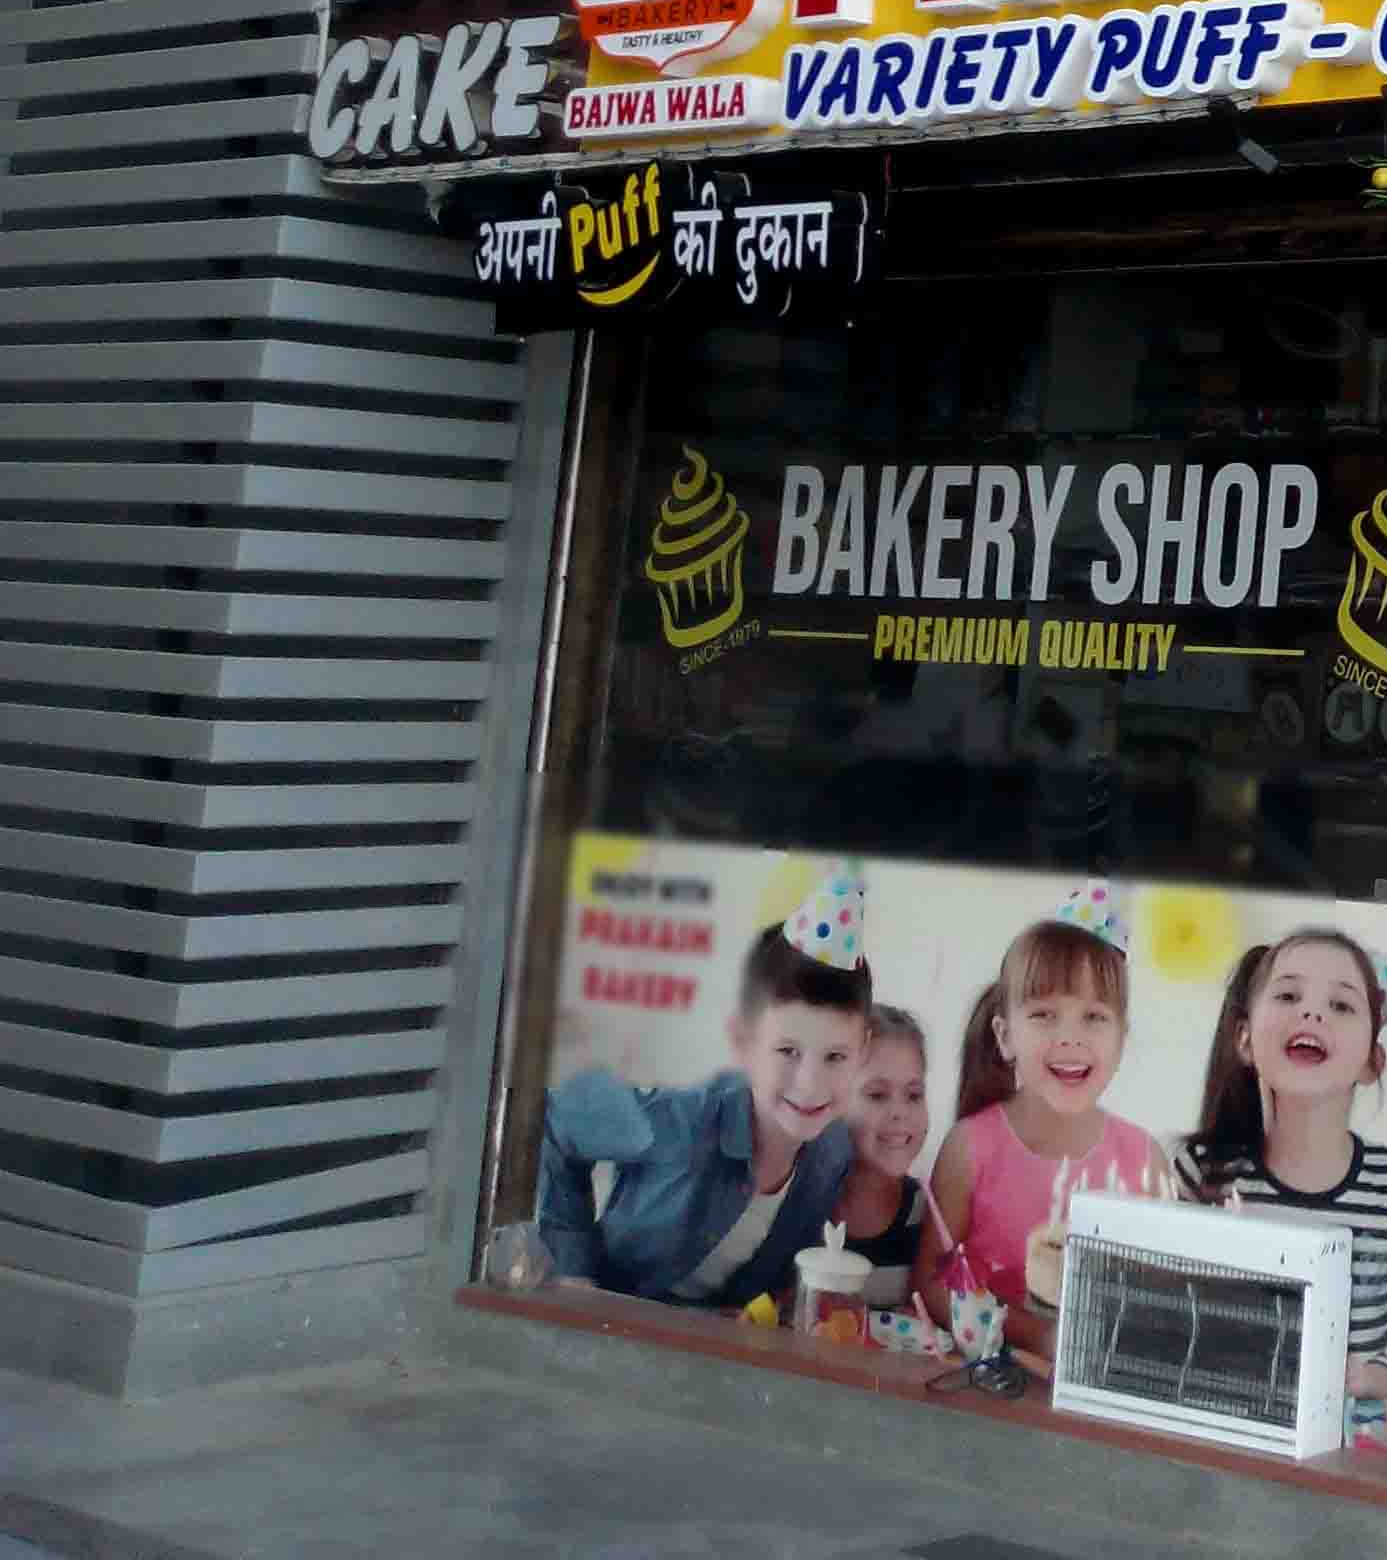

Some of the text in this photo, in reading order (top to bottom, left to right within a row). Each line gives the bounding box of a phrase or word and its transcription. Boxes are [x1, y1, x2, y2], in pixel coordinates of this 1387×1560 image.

[617, 0, 712, 28] BAKERY
[785, 21, 1076, 122] VARIETY
[1093, 1, 1288, 91] PUFF
[308, 17, 560, 160] CAKE
[569, 81, 746, 130] BAJWA WALA
[475, 163, 832, 304] अपनी Puff की दुकान
[771, 462, 1319, 608] BAKERY SHOP
[873, 615, 1178, 673] PREMIUM QUALITY
